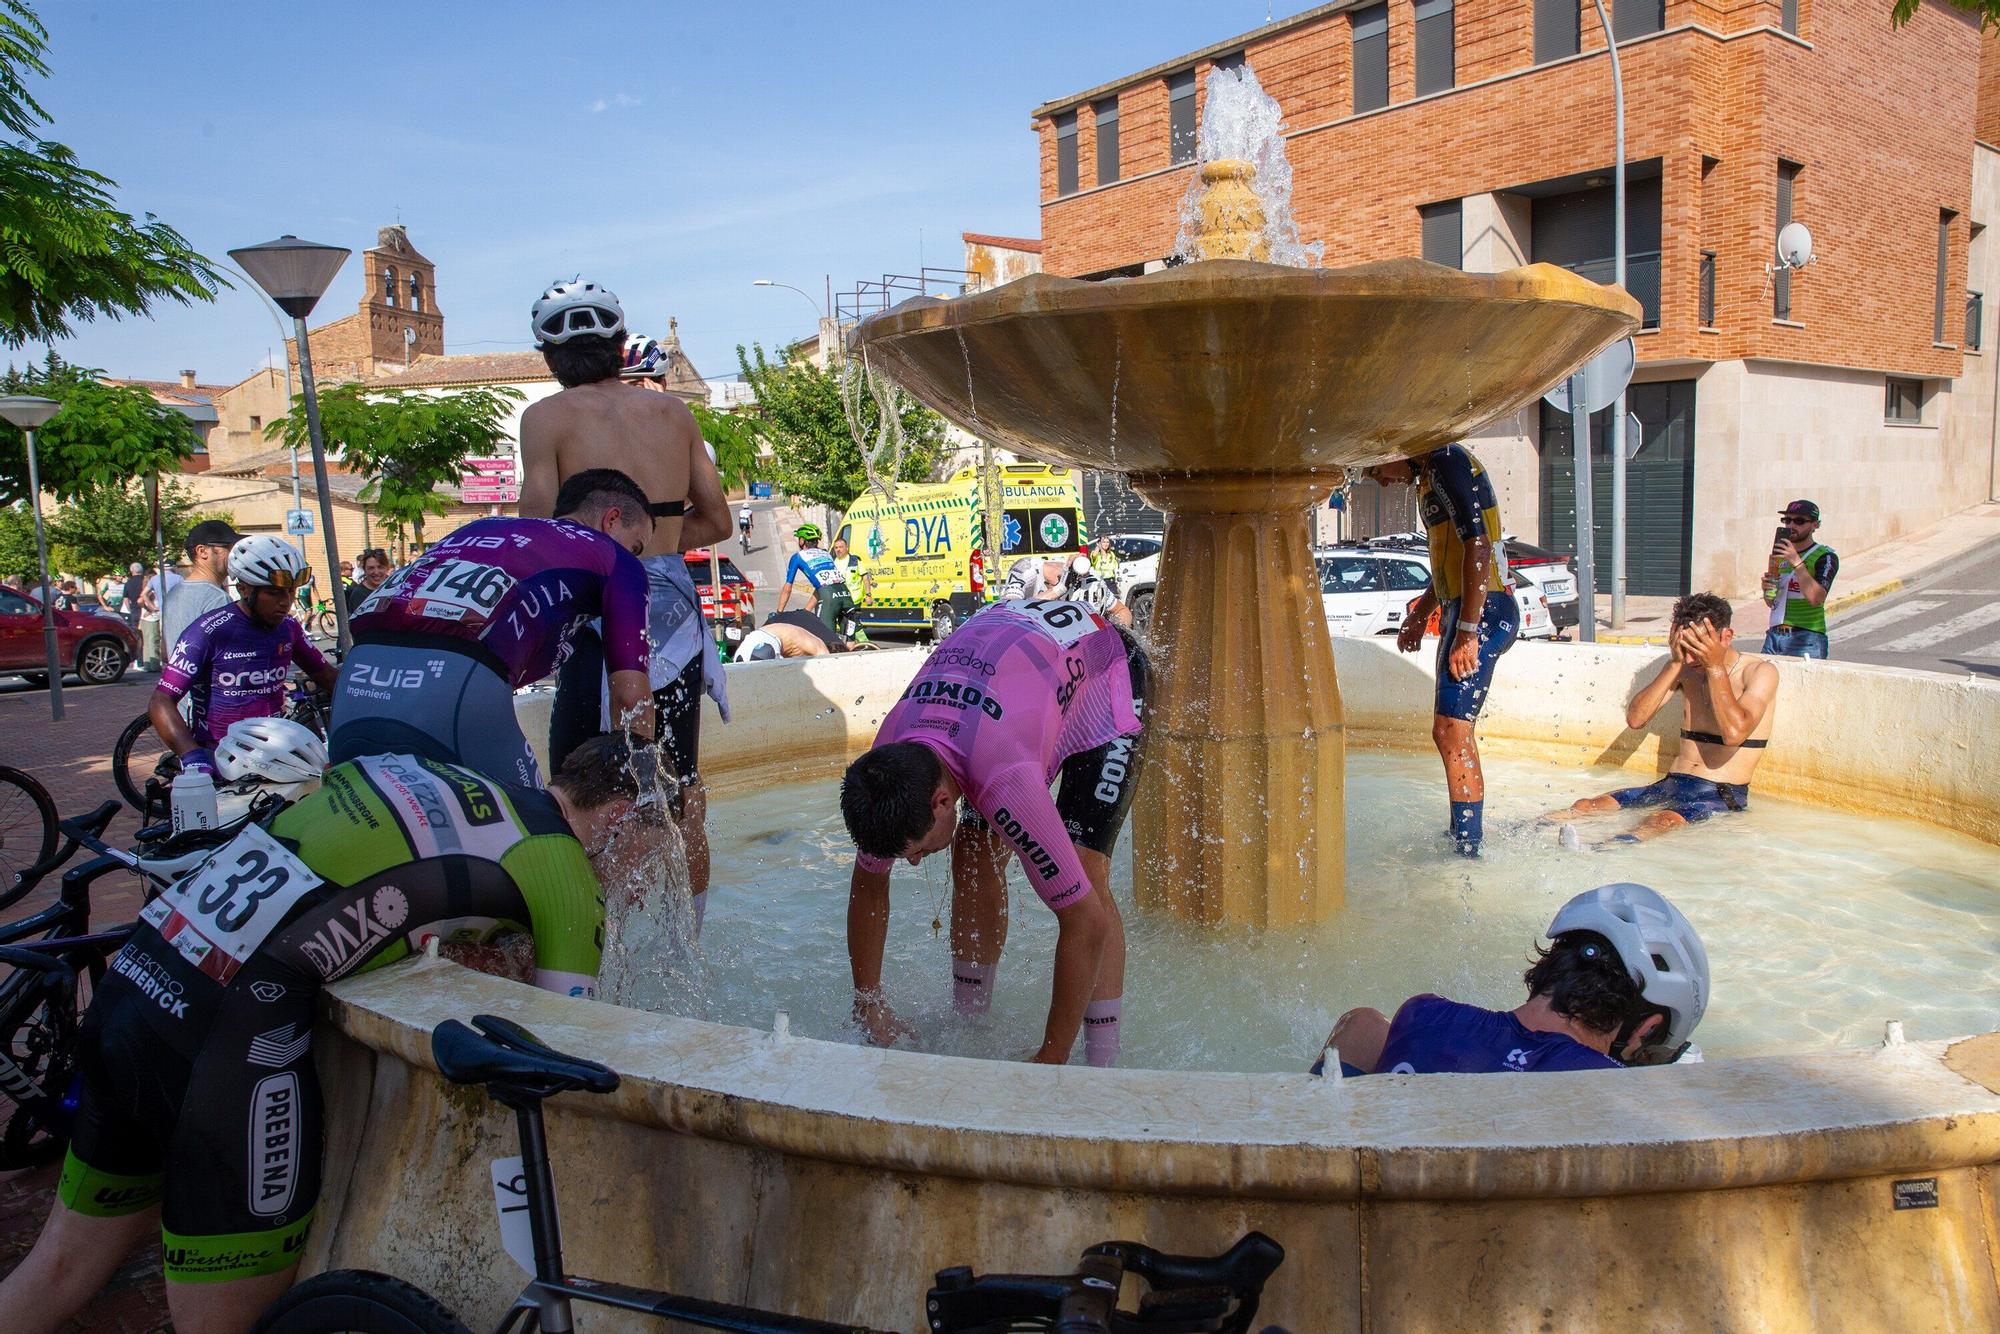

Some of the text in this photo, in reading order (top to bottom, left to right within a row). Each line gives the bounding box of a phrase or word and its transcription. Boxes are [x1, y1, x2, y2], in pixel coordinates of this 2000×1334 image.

[905, 514, 952, 555] DYA
[425, 560, 513, 609] 146
[508, 579, 574, 641] ZUIA
[916, 697, 968, 711] GRUPO
[992, 805, 1060, 882] GOMUR
[197, 849, 290, 933] 33
[112, 952, 191, 1020] HEMERYCK
[124, 942, 185, 996] ELEKTRO
[260, 1087, 291, 1201] PREBENA
